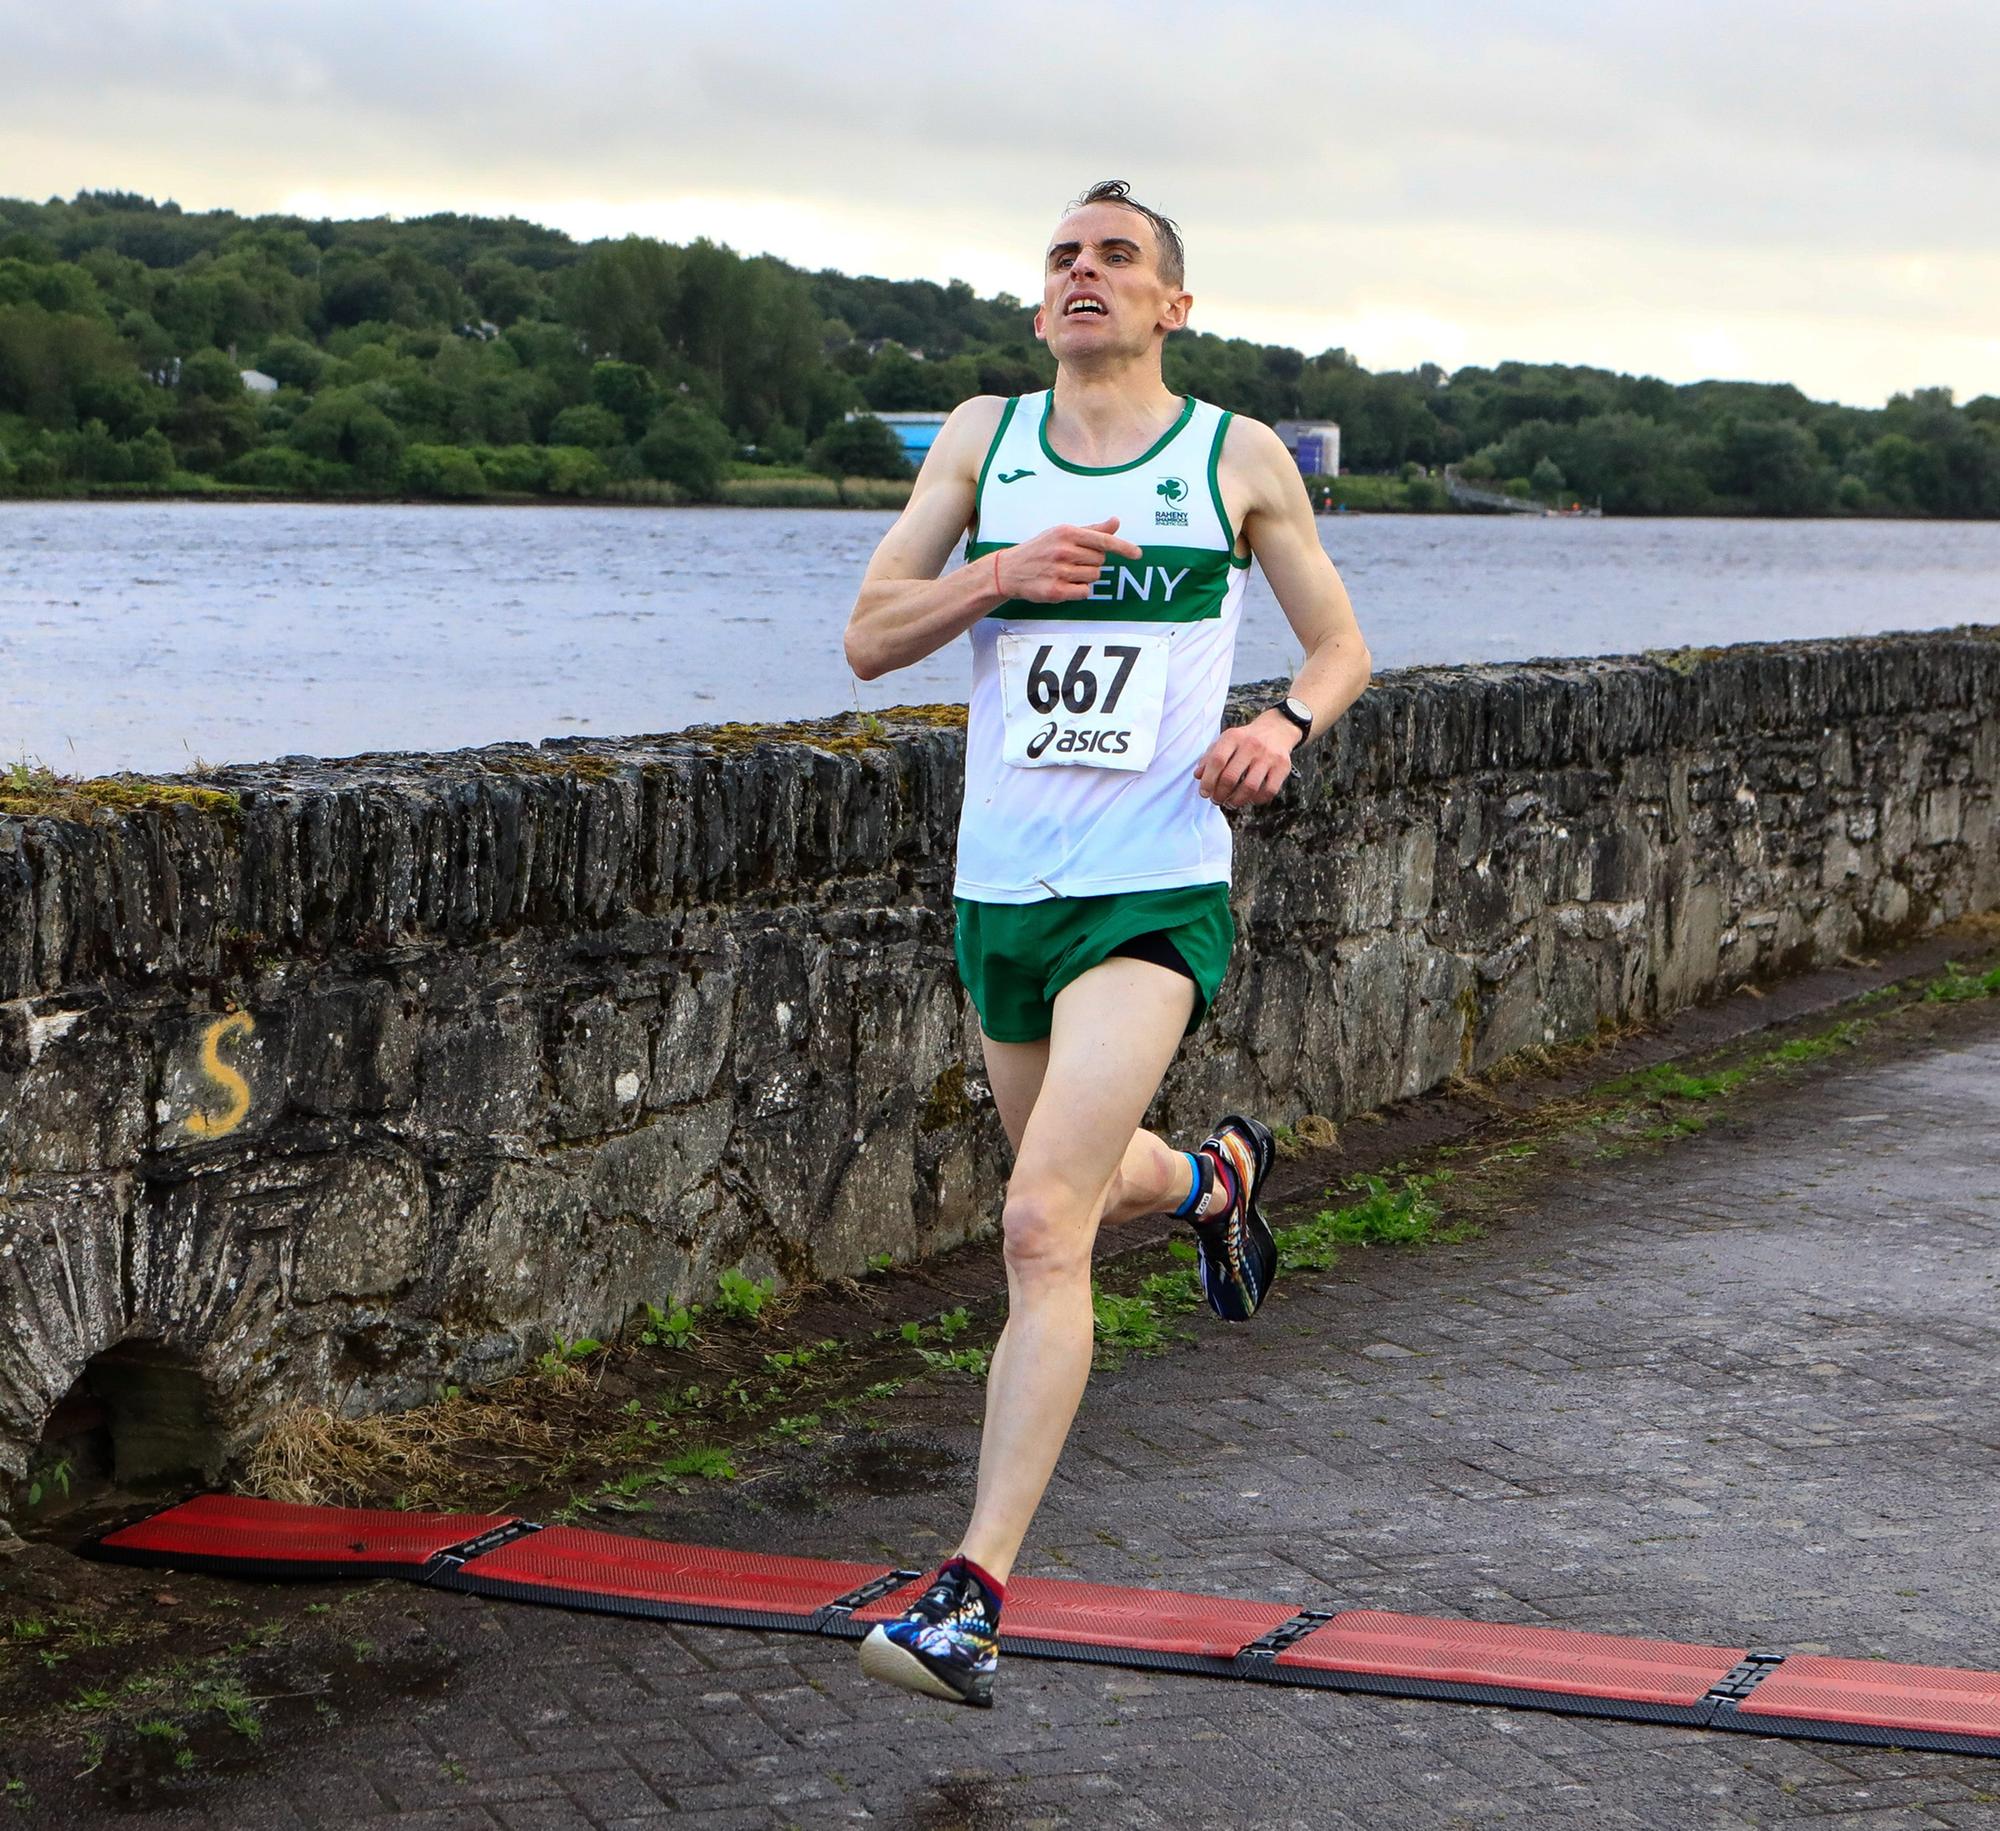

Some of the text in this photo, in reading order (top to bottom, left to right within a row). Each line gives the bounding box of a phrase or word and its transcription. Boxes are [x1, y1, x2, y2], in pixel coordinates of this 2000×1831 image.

[1087, 566, 1191, 602] ENY
[1026, 645, 1142, 715] 667
[184, 1010, 256, 1136] S
